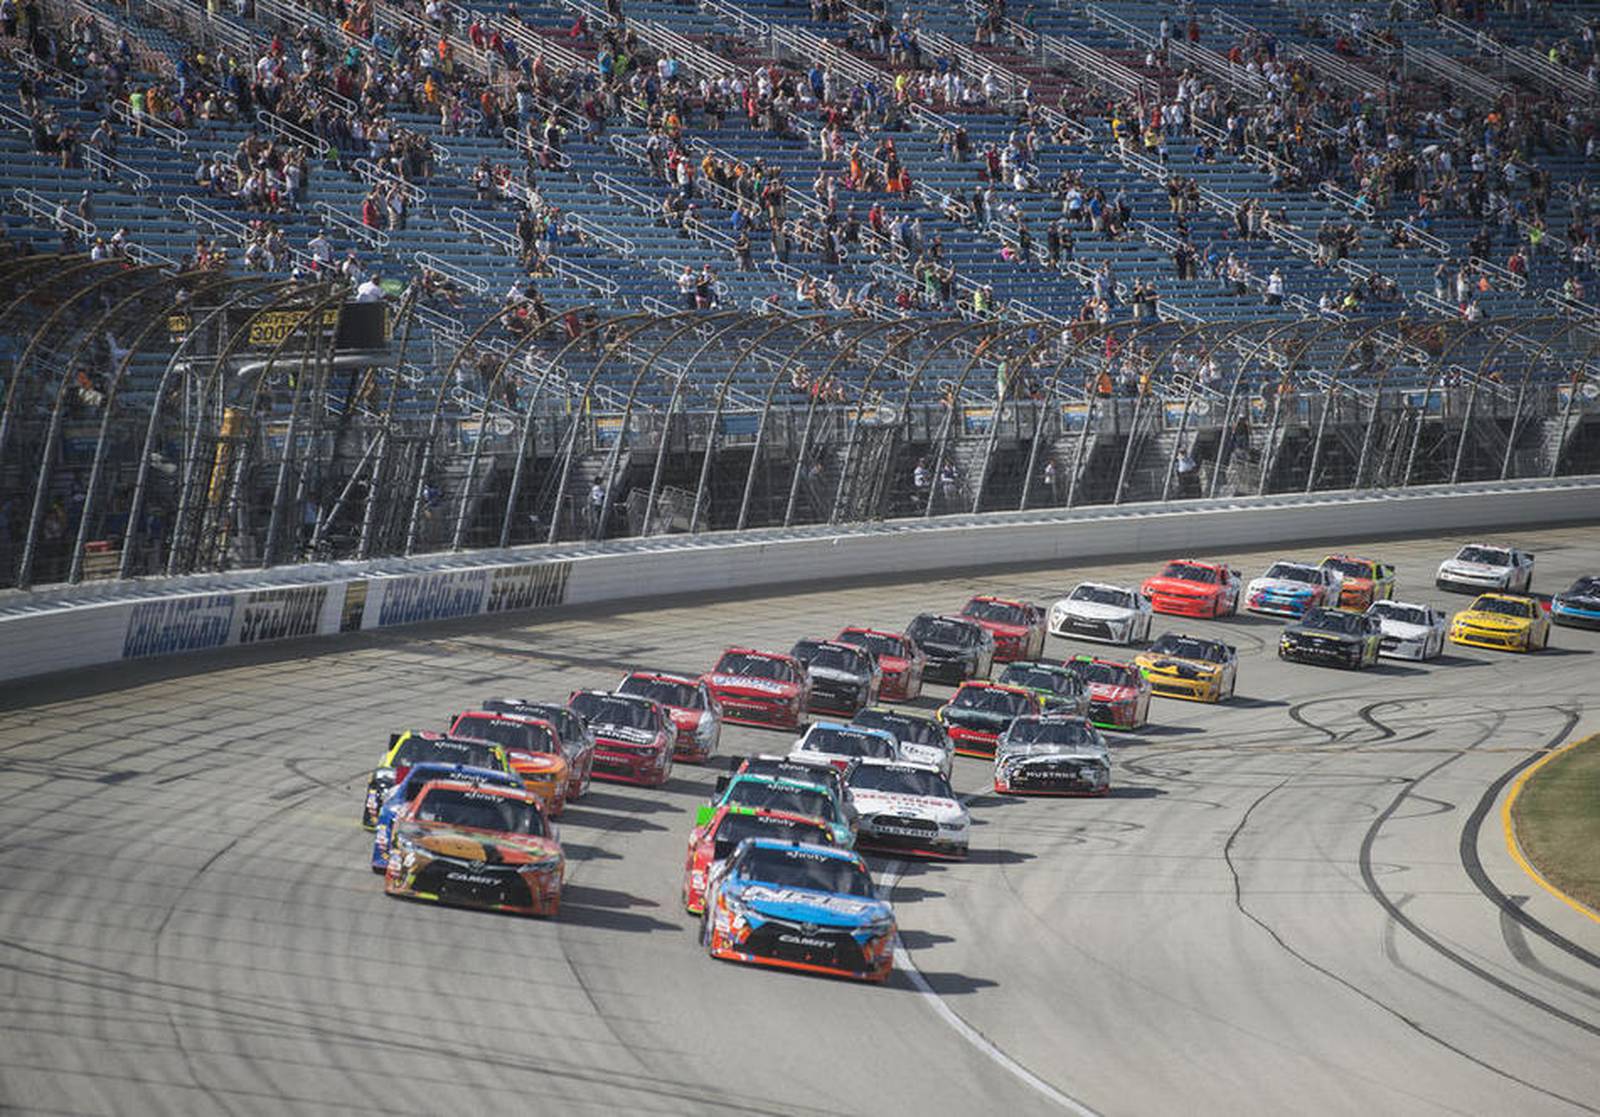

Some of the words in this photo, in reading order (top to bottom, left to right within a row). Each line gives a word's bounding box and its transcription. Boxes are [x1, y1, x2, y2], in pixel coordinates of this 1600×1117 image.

[786, 850, 828, 862] xfinity
[447, 871, 503, 886] CAMRY
[778, 934, 836, 948] CAMRY
